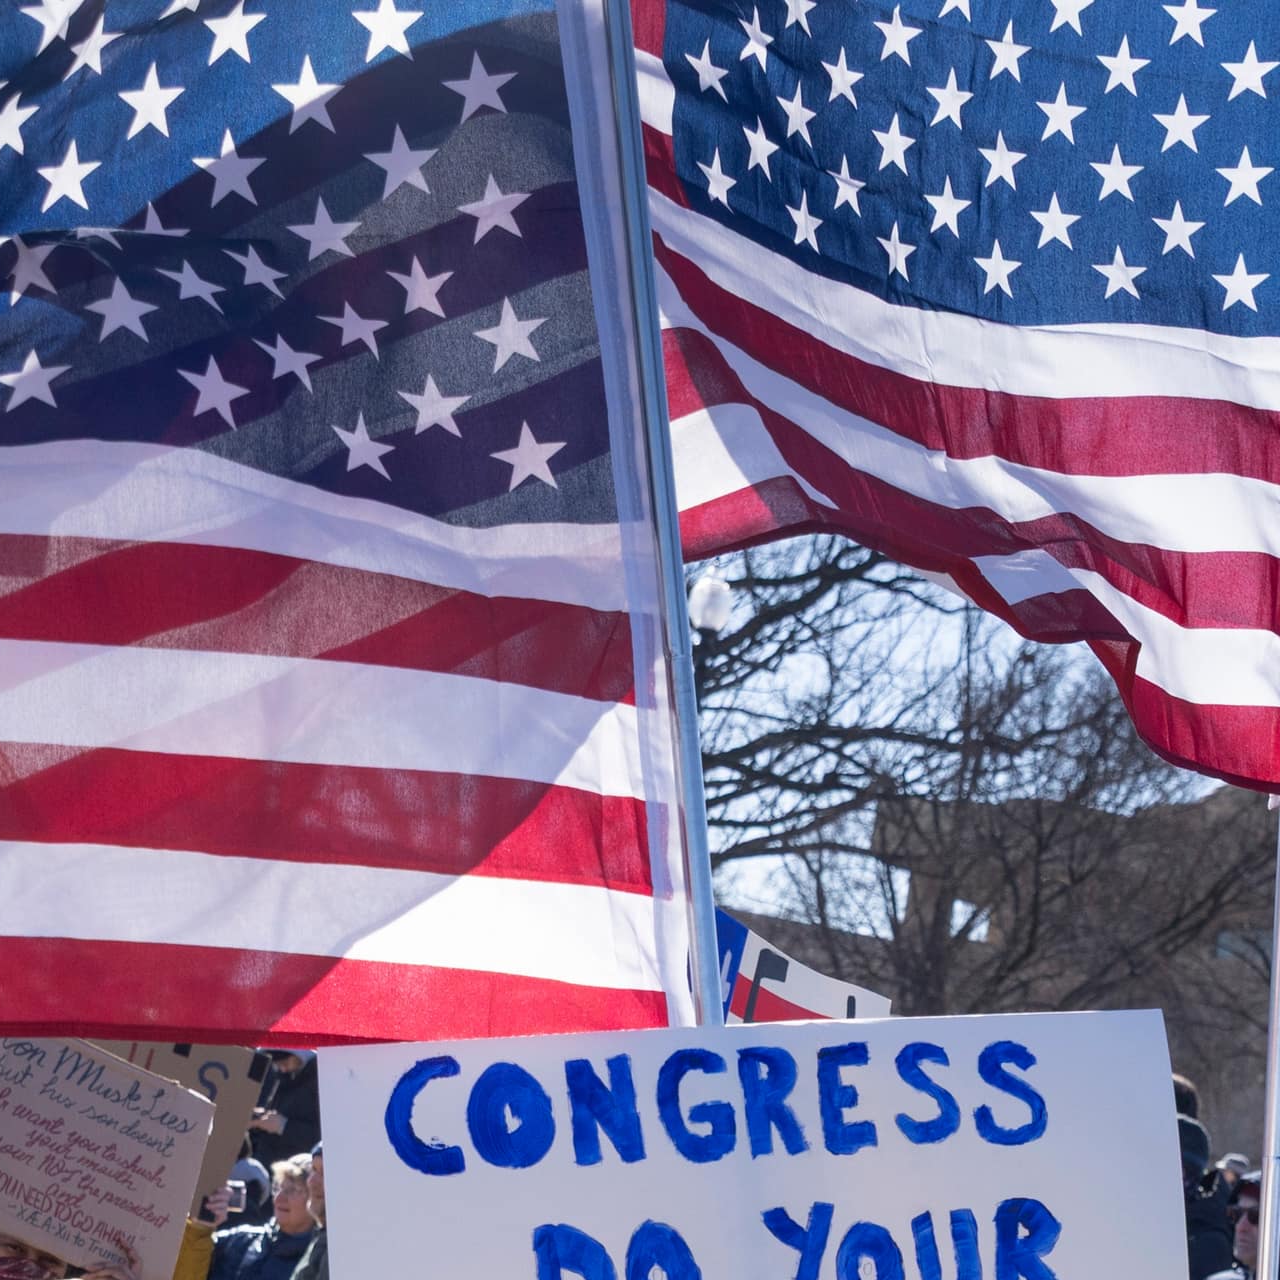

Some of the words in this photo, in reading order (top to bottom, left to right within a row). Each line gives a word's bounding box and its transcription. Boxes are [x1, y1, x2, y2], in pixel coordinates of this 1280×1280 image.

[52, 1045, 141, 1113] Musk
[140, 1088, 199, 1134] Lies
[384, 1040, 1049, 1176] CONGRESS
[11, 1103, 65, 1136] want
[66, 1130, 103, 1155] you
[78, 1104, 121, 1130] son
[44, 1182, 88, 1210] and
[77, 1155, 138, 1192] mouth
[77, 1174, 101, 1198] the
[97, 1191, 170, 1229] president
